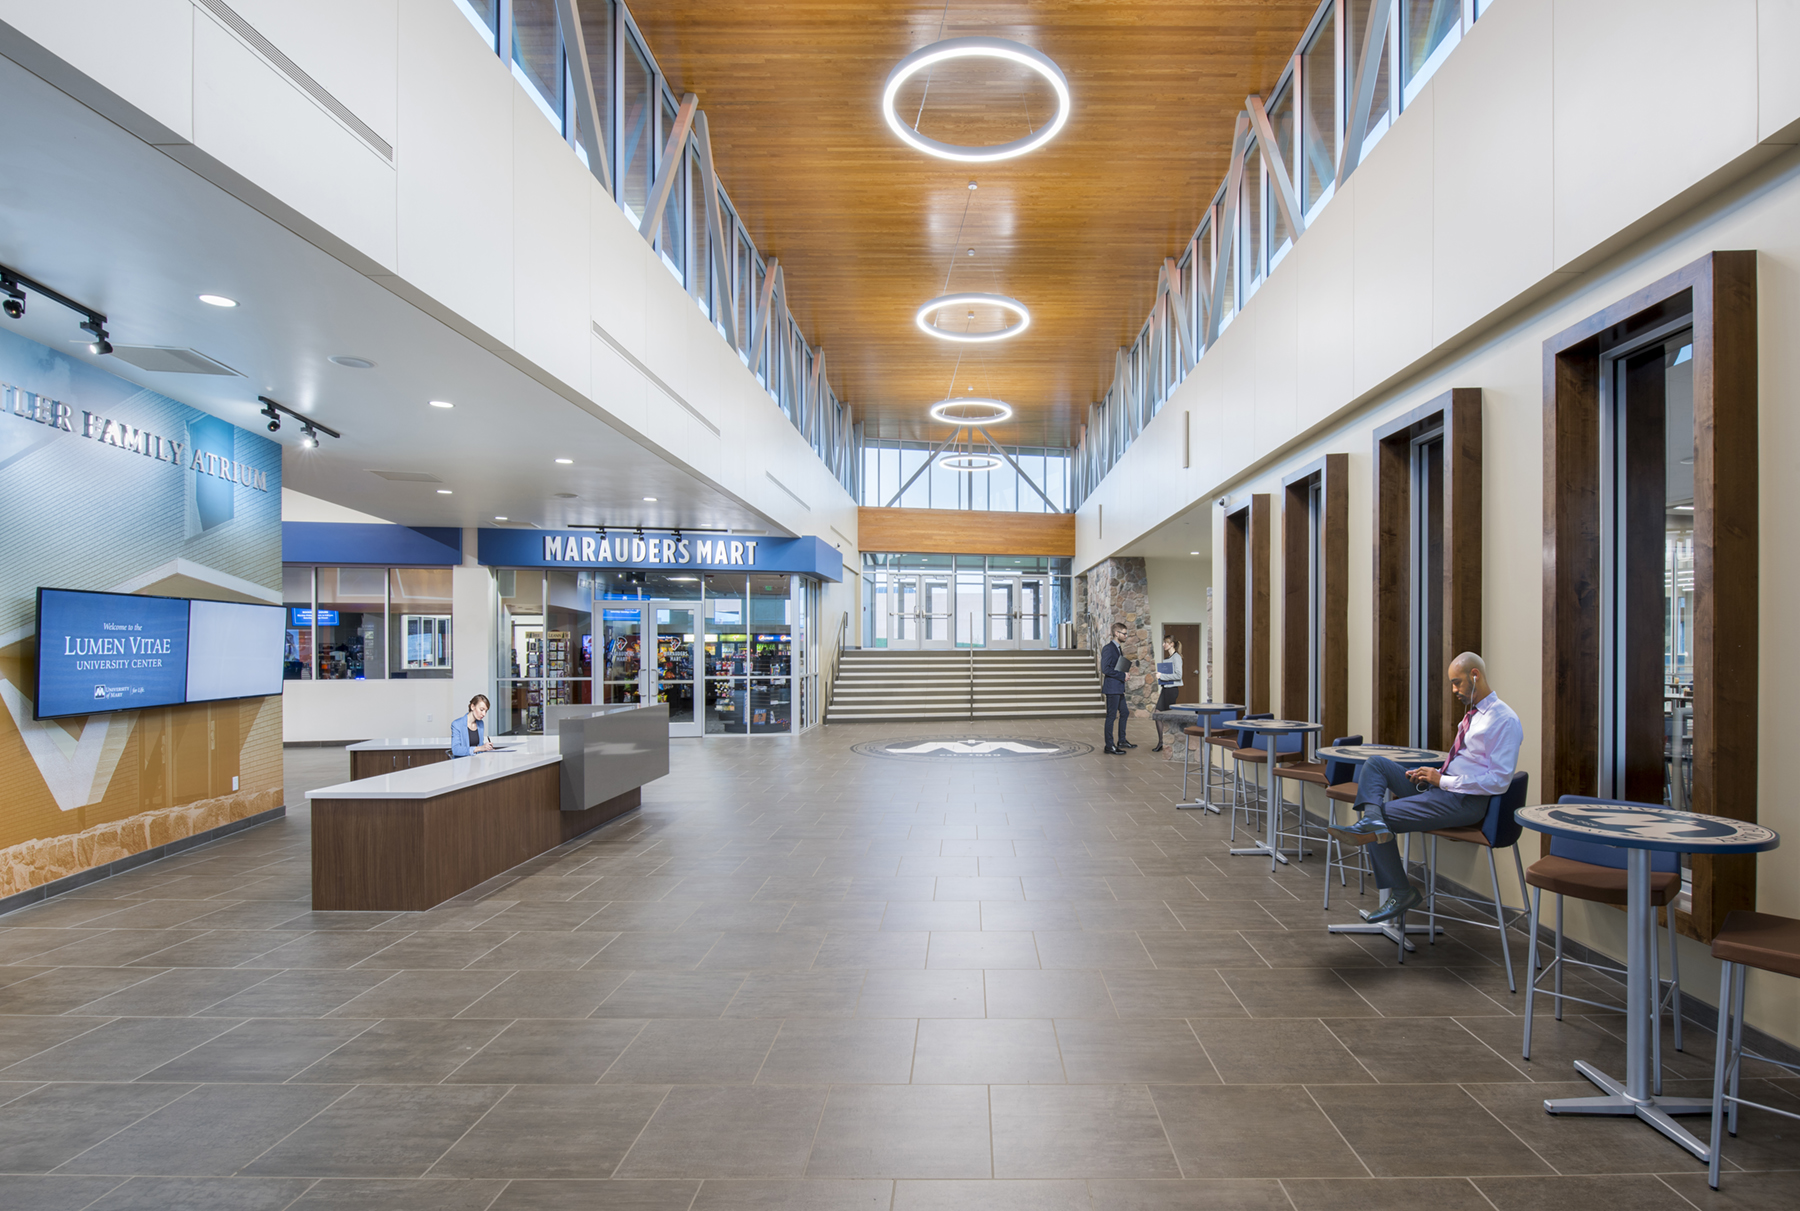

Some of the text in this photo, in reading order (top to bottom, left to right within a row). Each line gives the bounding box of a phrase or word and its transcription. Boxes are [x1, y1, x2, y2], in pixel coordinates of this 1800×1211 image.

[82, 409, 187, 465] FAMILY
[190, 448, 268, 492] ATRIUM
[544, 536, 758, 565] MARAUDERS MART
[103, 622, 127, 631] Welcome
[134, 623, 142, 631] the
[64, 636, 171, 655] LUMEN VITAE
[76, 659, 162, 670] UNIVERSITY CENTER
